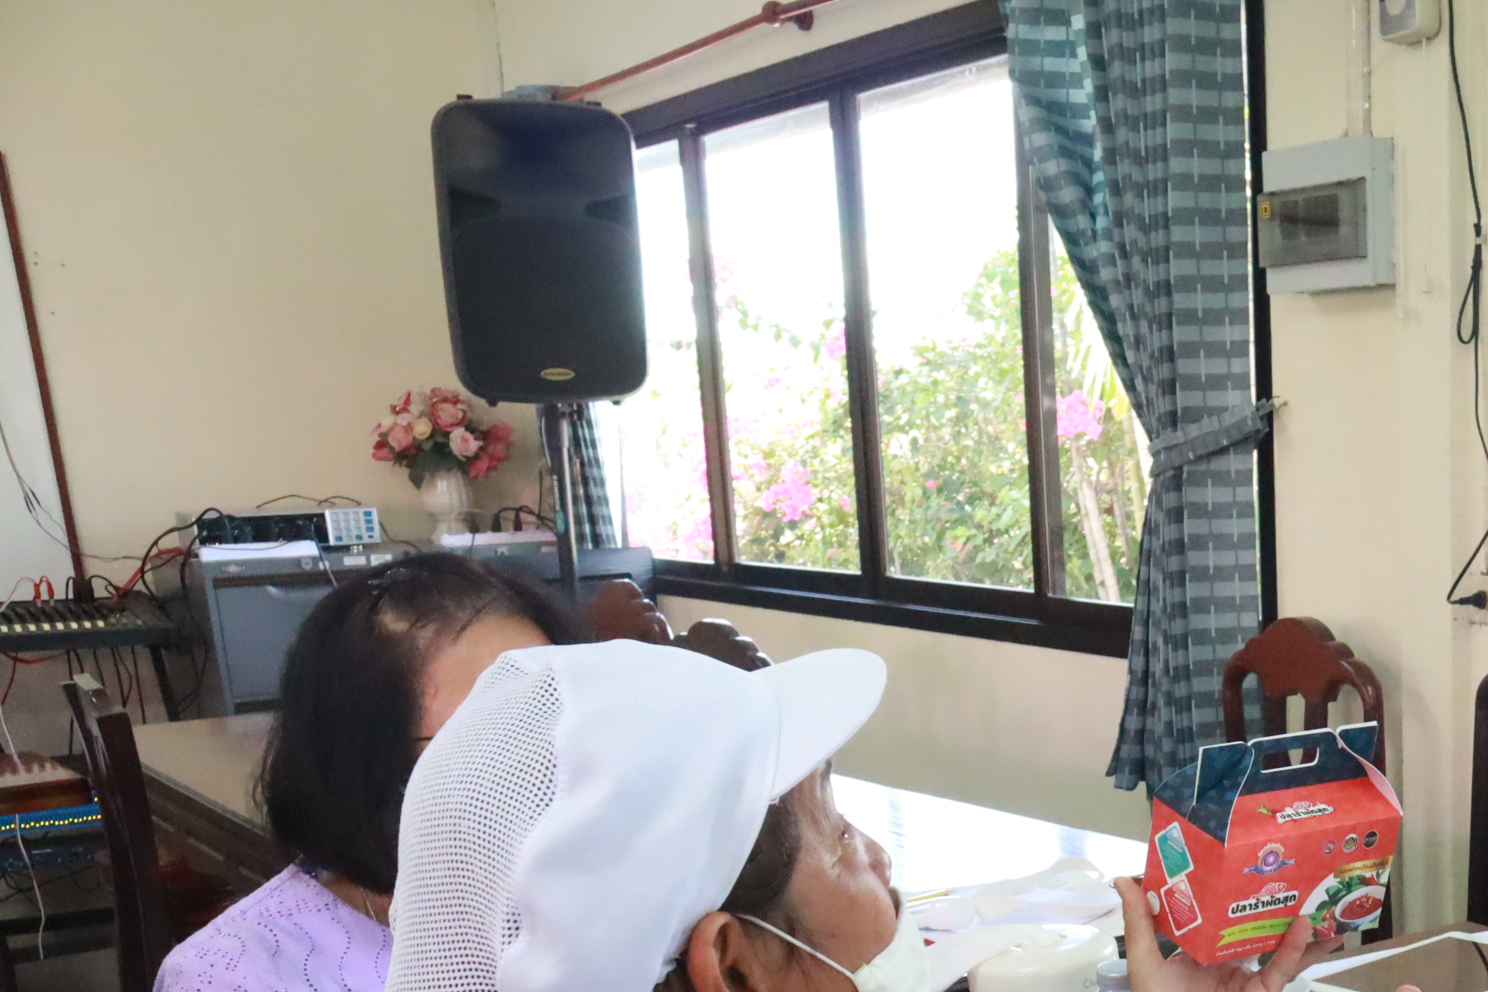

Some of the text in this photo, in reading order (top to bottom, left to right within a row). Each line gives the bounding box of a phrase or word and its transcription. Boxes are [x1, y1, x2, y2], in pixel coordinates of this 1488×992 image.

[1231, 893, 1297, 915] ปลาร้าผัดสุก
